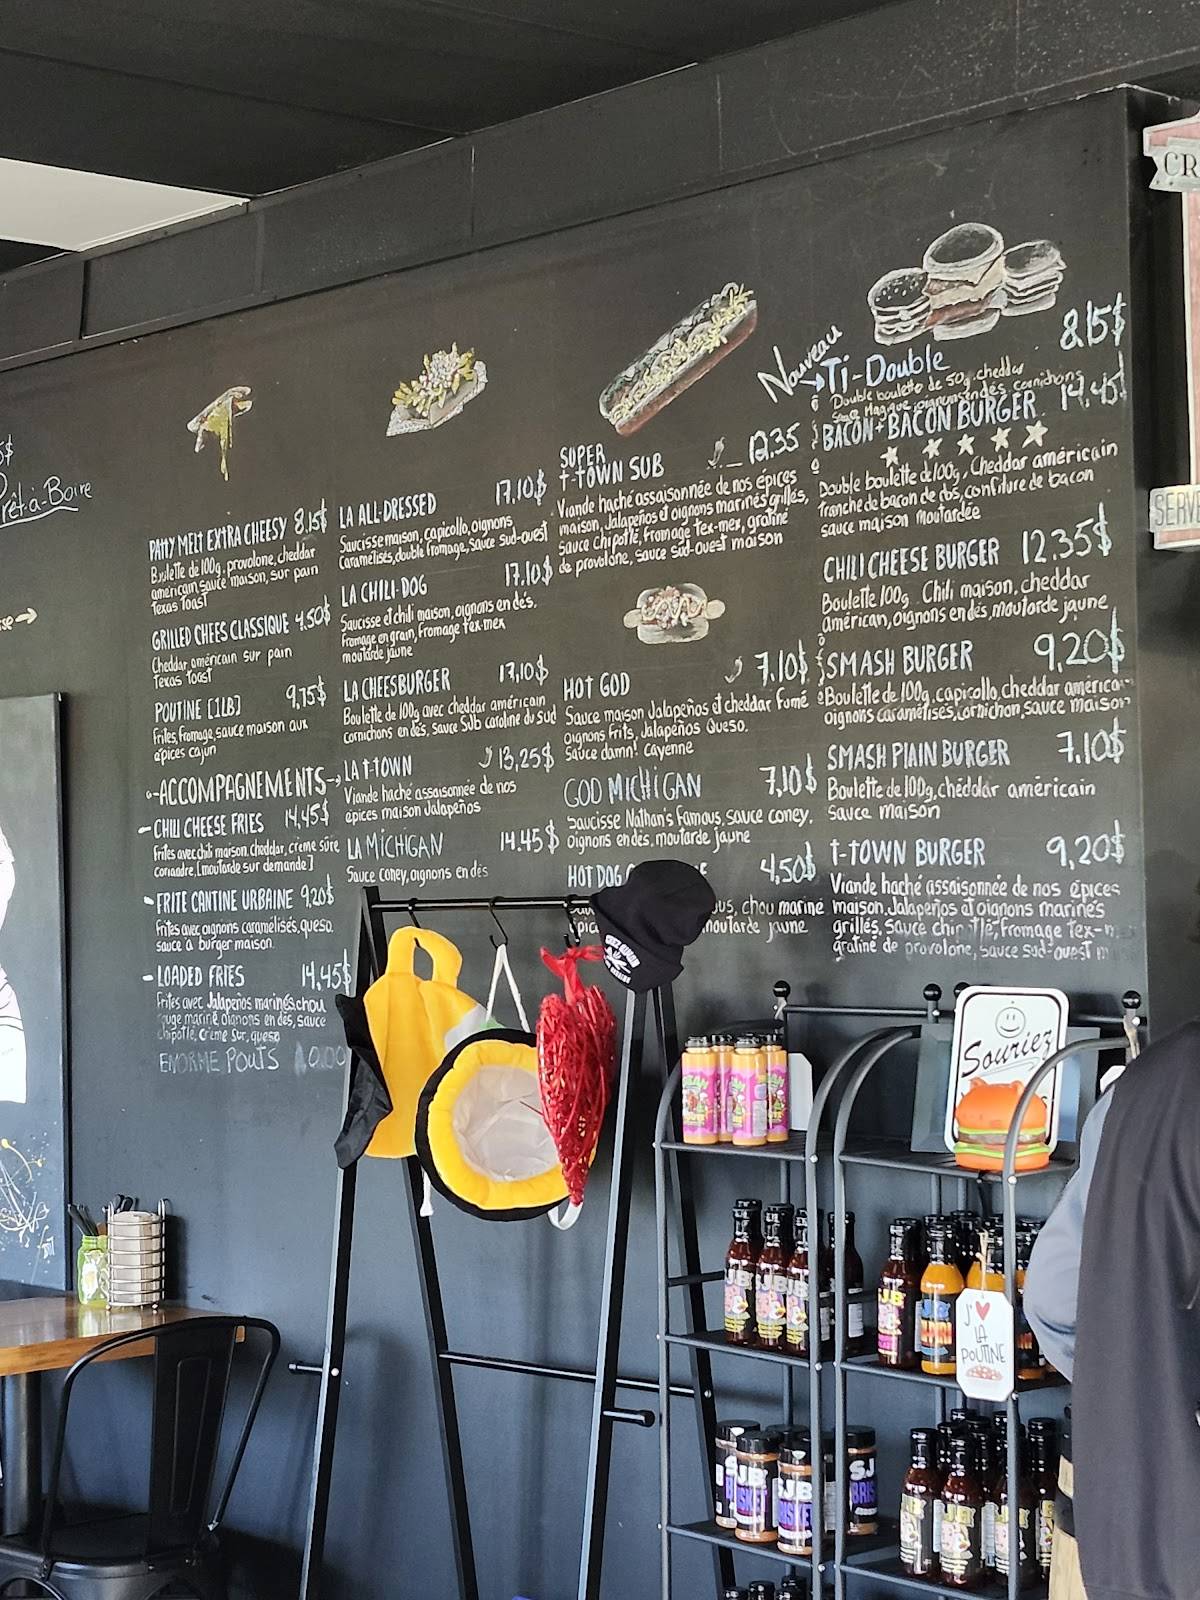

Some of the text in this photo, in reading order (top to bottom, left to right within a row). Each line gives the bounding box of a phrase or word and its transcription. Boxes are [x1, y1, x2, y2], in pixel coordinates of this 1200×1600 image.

[757, 325, 843, 403] Nouveau
[876, 355, 1024, 401] boulette cheddar
[957, 391, 1037, 430] BURGER
[559, 443, 606, 468] SUPER
[630, 452, 665, 481] SUB
[865, 439, 1118, 489] boulette Cheddar américain
[557, 480, 712, 519] Viande assaisonnée
[818, 466, 1095, 518] tranche bacon confiture bacon
[339, 506, 353, 529] LA
[471, 515, 513, 538] oignons
[671, 503, 714, 528] oignons
[820, 515, 909, 538] sauce maison
[244, 517, 287, 545] CHEESY
[499, 520, 548, 547] sud-ouest
[558, 539, 589, 557] sauce
[635, 532, 783, 564] sauce sud-ouest maison
[823, 554, 865, 583] CHILI
[868, 545, 929, 580] CHEESE
[936, 537, 1000, 571] BURGER
[151, 542, 316, 584] Boulette cheddar
[341, 585, 357, 607] LA
[822, 567, 1091, 616] Boulette cheddar
[455, 600, 494, 622] oignons
[892, 594, 1109, 631] oignons moutarde jaune
[152, 626, 192, 651] GRILLED
[194, 624, 228, 646] CHEES
[230, 613, 289, 640] CLASSIQUE
[463, 616, 506, 634] tex-mex
[152, 654, 188, 673] Cheddar
[342, 648, 384, 664] moutarde
[826, 652, 895, 680] SMASH
[903, 639, 974, 675] BURGER
[343, 680, 359, 703] LA
[362, 667, 450, 701] CHEESBURGER
[600, 672, 631, 697] GOD
[824, 673, 1060, 706] Boulette cheddar
[155, 699, 201, 723] POUTINE
[343, 695, 546, 726] Boulette cheddar américain
[485, 713, 520, 729] caroline
[565, 696, 771, 726] Sauce maison cheddar
[824, 696, 1131, 730] oignons sauce maison
[247, 720, 285, 736] maison
[564, 731, 606, 751] oignons
[344, 760, 359, 782] LA
[499, 741, 555, 773] 13,25$
[565, 742, 694, 761] sauce cayenne
[828, 742, 887, 771] SMASH
[942, 739, 1011, 769] BURGER
[160, 766, 327, 806] ACCOMPAGNEMENTS
[344, 779, 476, 805] Viande assaisonnée
[564, 777, 603, 808] GOD
[828, 775, 1096, 801] Boulette américain
[382, 805, 421, 820] maison
[726, 810, 763, 828] sauce
[828, 801, 941, 821] sauce maison
[154, 817, 180, 839] CHILI
[184, 815, 227, 838] CHEESE
[231, 812, 264, 834] FRIES
[347, 837, 362, 860] LA
[500, 819, 560, 855] 14.45$
[567, 828, 750, 855] oignons moutarde jaune
[915, 837, 986, 867] BURGER
[410, 868, 451, 887] oignons
[598, 864, 622, 887] DOG
[830, 873, 1008, 898] Viande assaisonnée
[157, 891, 187, 914] FRITE
[192, 889, 237, 913] CANTINE
[242, 888, 293, 911] URBAINE
[975, 902, 1034, 926] oignons
[202, 921, 239, 940] oignons
[767, 920, 809, 944] jaune
[886, 919, 927, 935] sauce
[235, 936, 275, 949] maison
[157, 965, 202, 987] LOADED
[209, 964, 245, 988] FRIES
[962, 1030, 1052, 1080] Souriez
[975, 1324, 988, 1344] LA
[961, 1343, 1007, 1365] POUTINE
